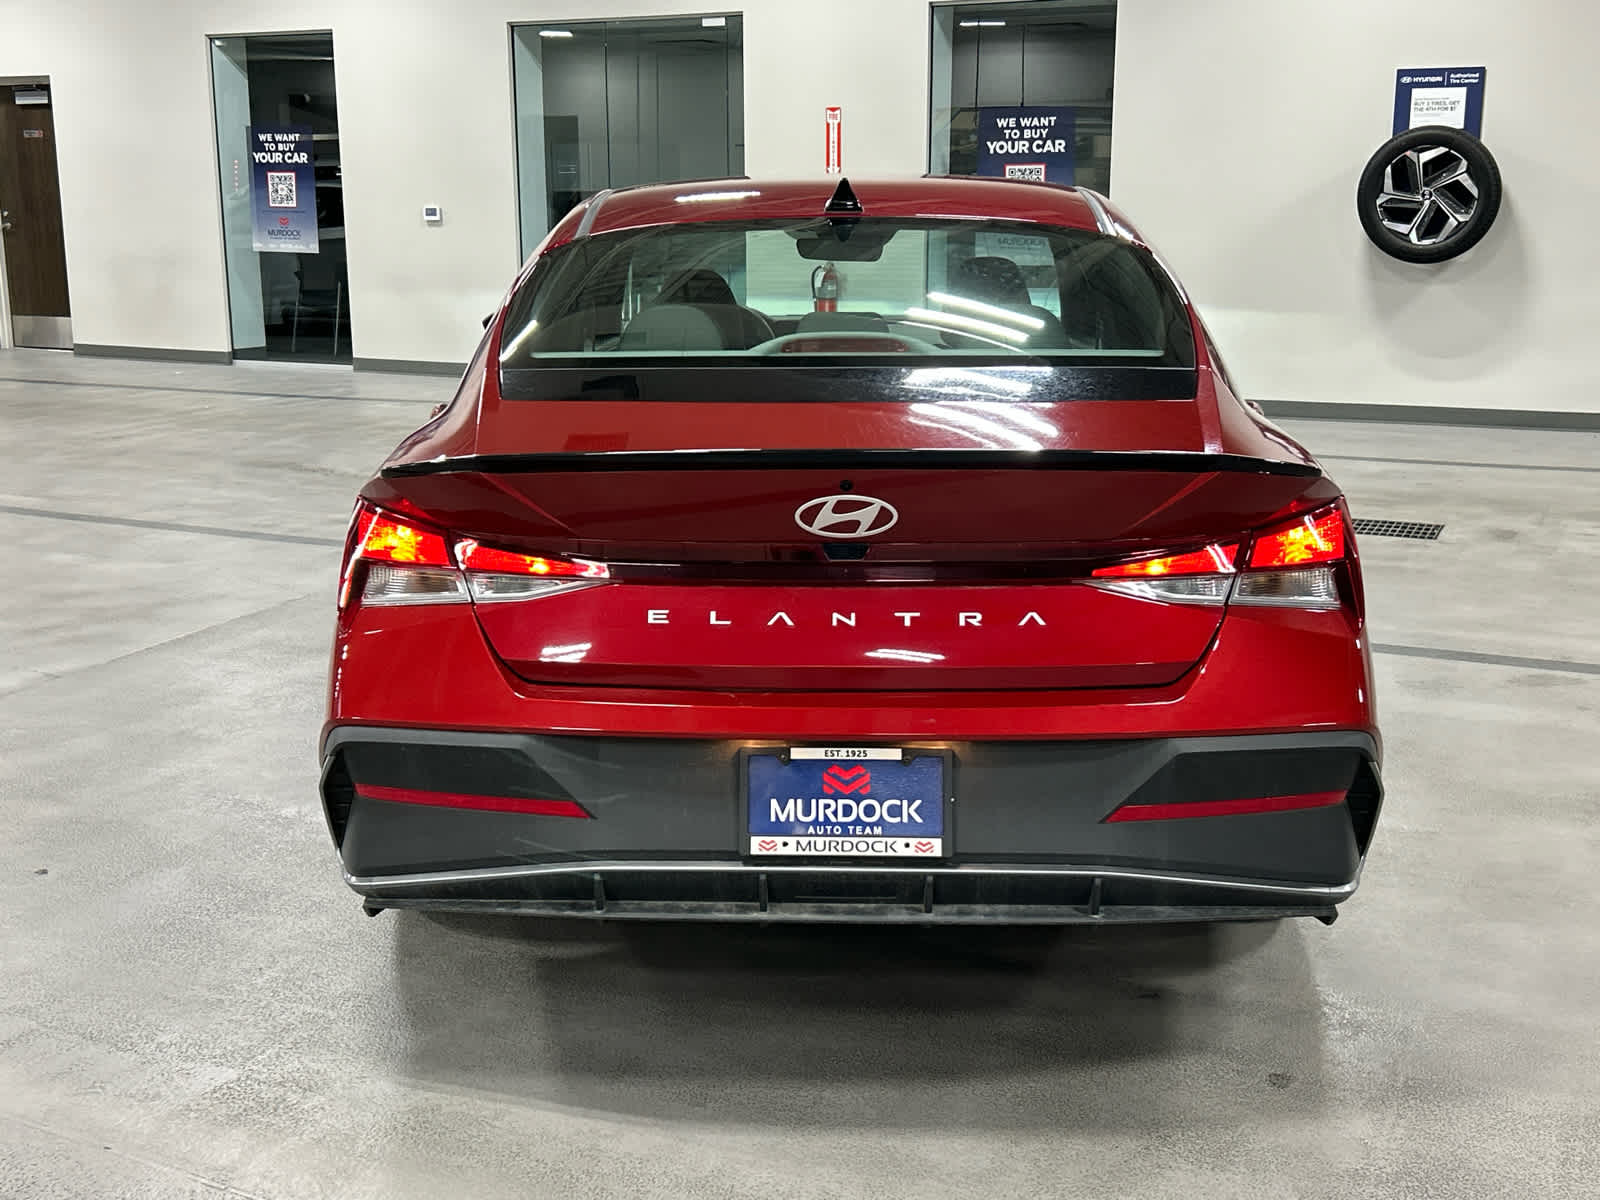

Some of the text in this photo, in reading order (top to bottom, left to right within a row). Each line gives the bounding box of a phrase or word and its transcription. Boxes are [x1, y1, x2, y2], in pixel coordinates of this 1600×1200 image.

[996, 116, 1056, 128] WE WANT
[1004, 128, 1048, 139] TO BUY
[264, 143, 295, 151] TO BUY
[986, 139, 1066, 154] YOUR CAR
[252, 152, 308, 163] YOUR CAR
[647, 609, 1047, 626] ELANTRA
[824, 750, 868, 758] EST. 1925
[770, 798, 923, 824] MURDOCK
[808, 825, 882, 836] AUTO TEAM
[796, 840, 899, 853] MURDOCK
